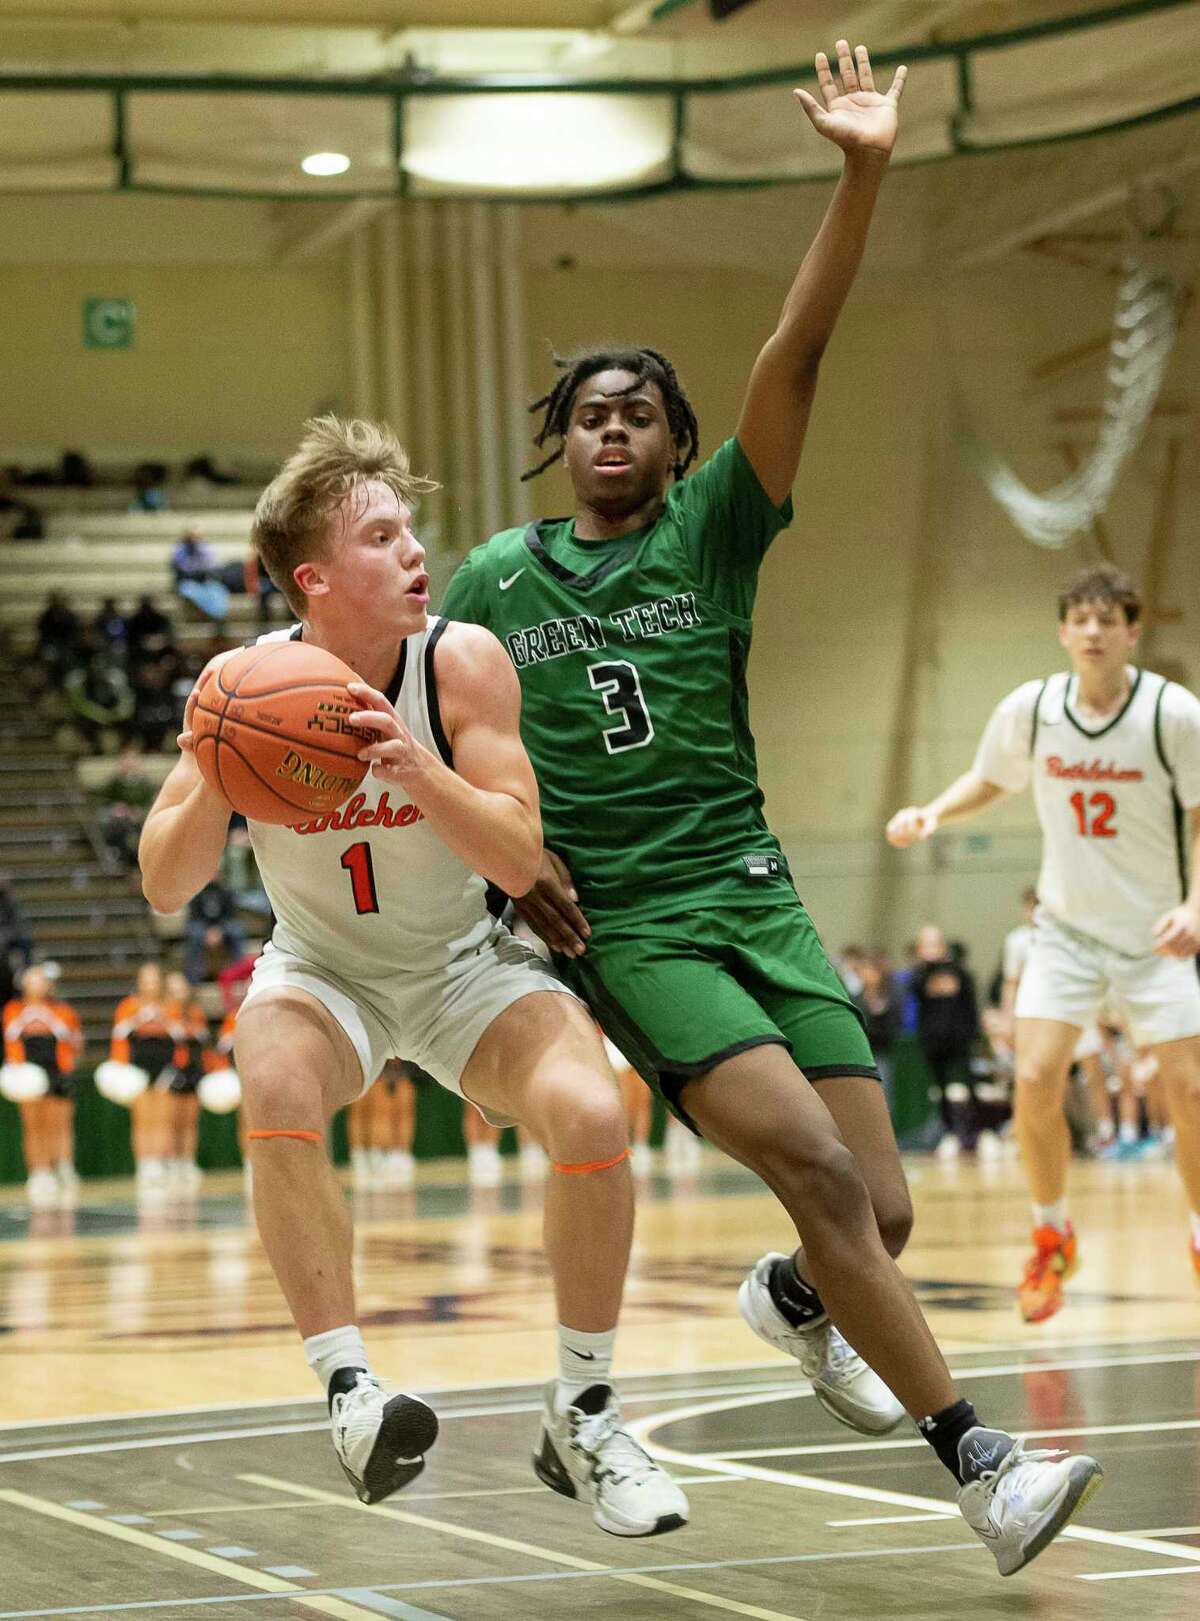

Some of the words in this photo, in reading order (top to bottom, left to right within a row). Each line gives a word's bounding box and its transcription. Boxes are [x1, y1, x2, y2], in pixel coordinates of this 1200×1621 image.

[507, 614, 606, 669] GREEN
[609, 591, 701, 642] TECH
[587, 659, 655, 755] 3
[1070, 791, 1117, 837] 12
[341, 842, 380, 915] 1
